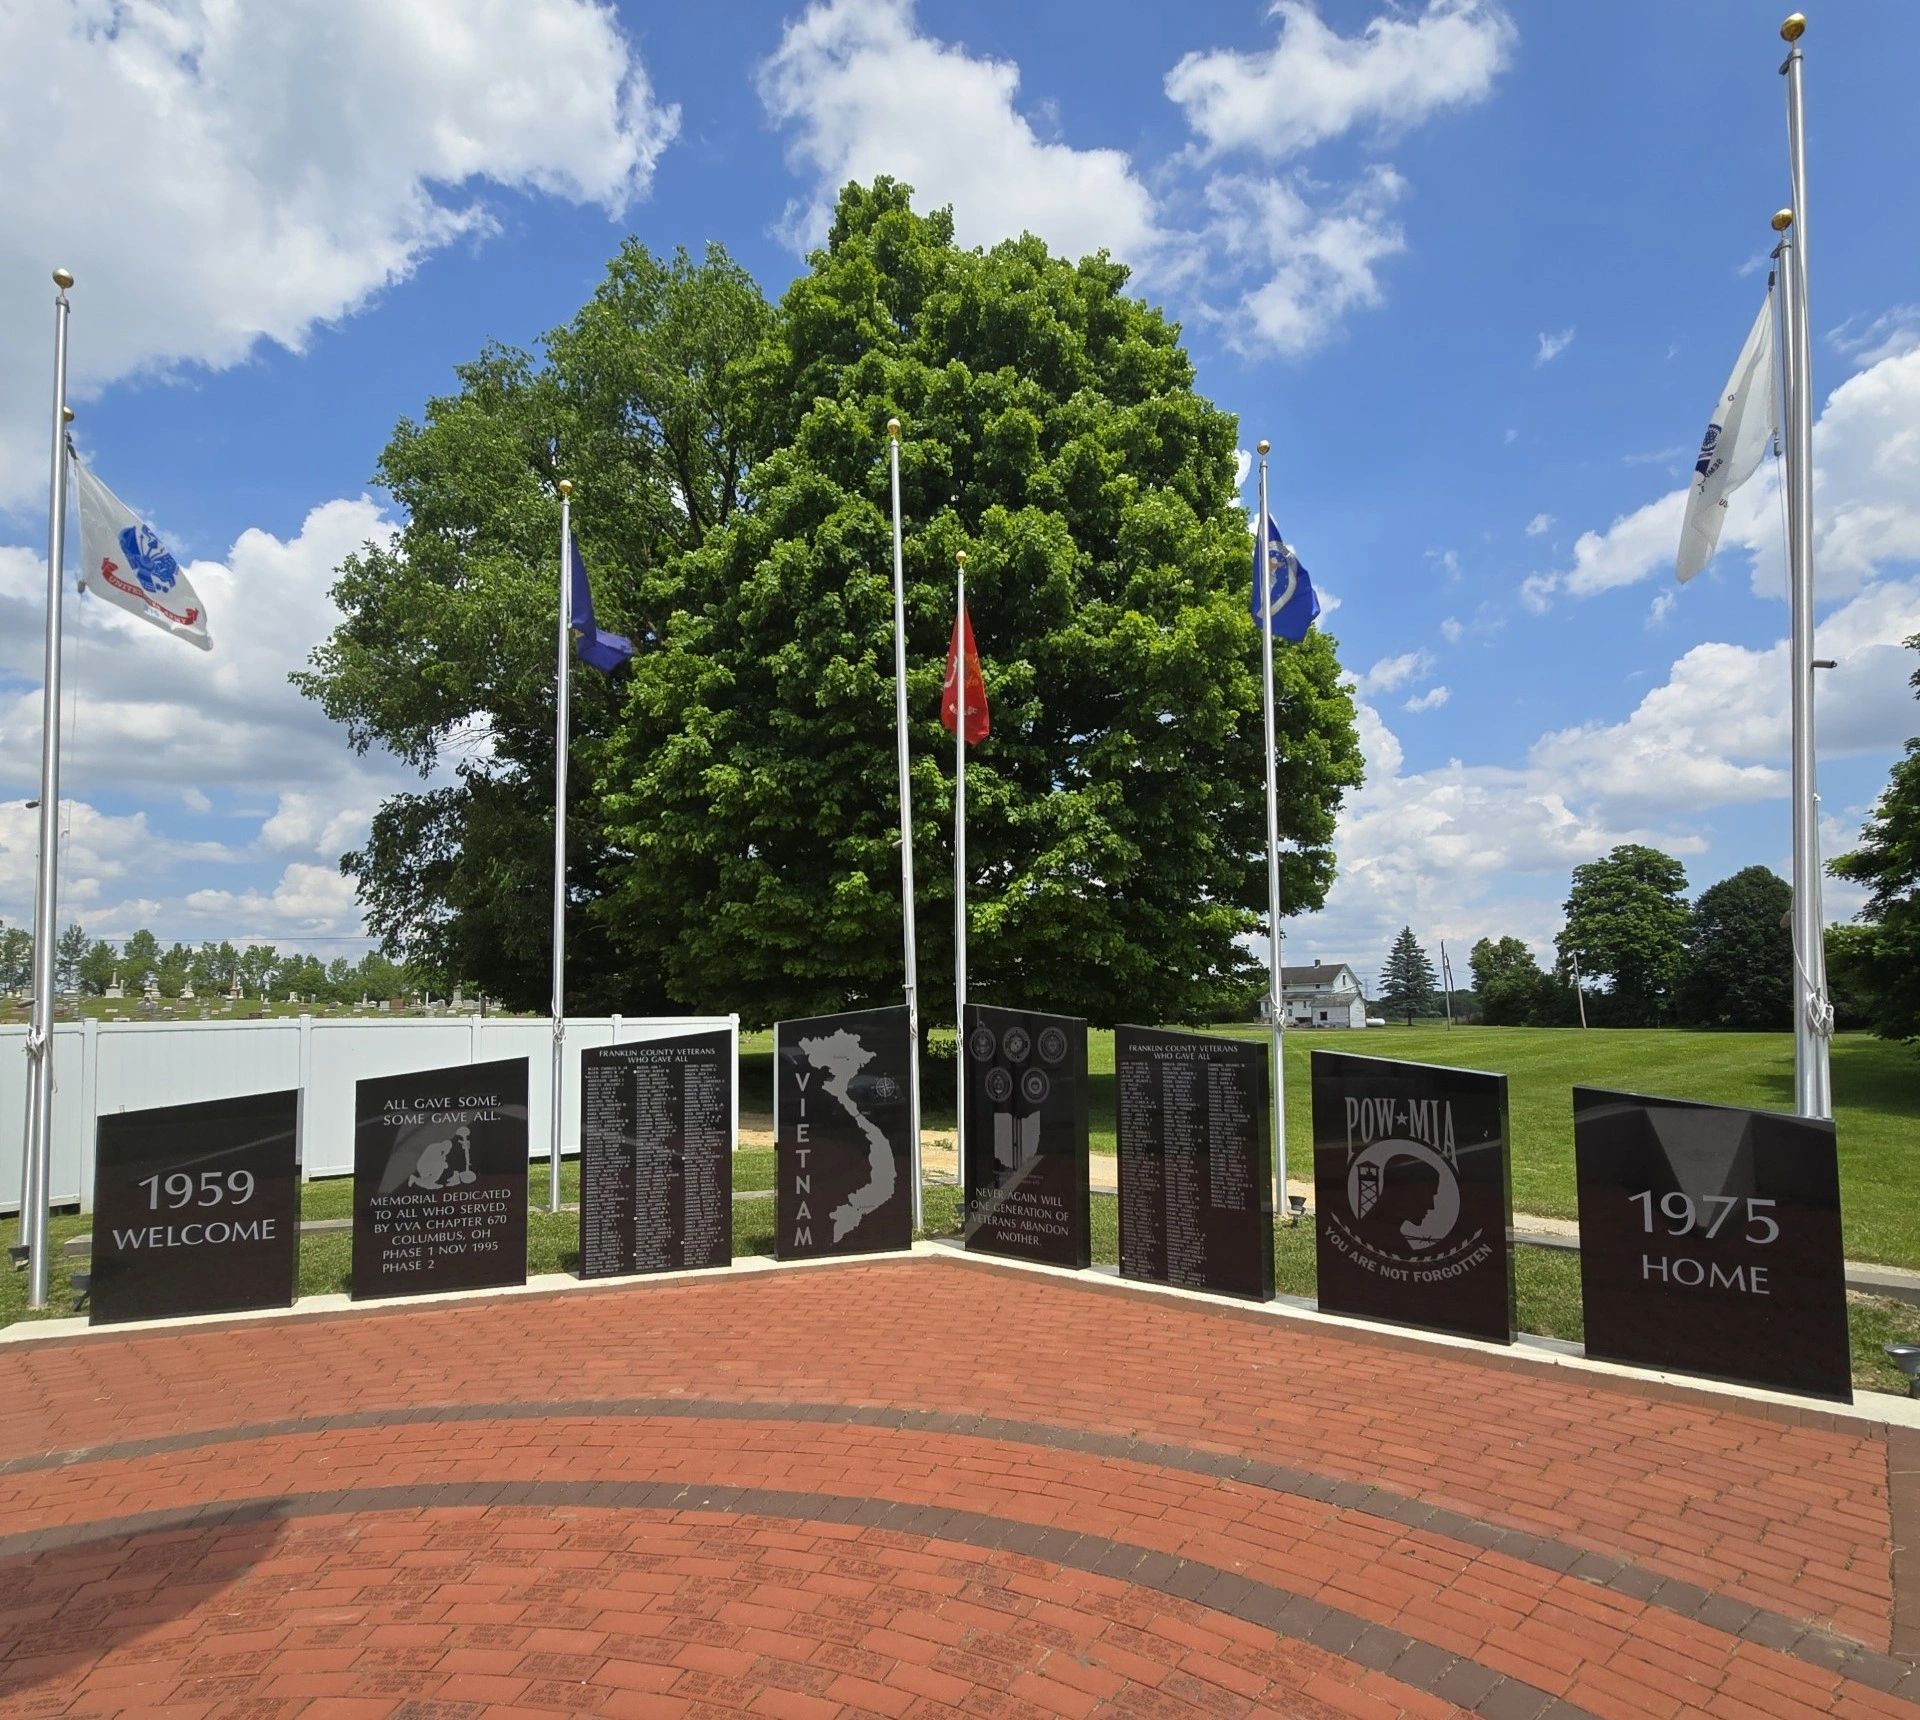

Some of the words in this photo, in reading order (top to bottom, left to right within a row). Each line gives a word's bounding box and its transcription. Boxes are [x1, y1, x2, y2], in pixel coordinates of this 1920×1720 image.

[599, 1049, 638, 1057] FRANKLIN
[640, 1048, 675, 1056] COUNTY
[677, 1047, 716, 1055] VETERANS
[1128, 1044, 1162, 1052] FRANKLIN
[1164, 1044, 1197, 1052] COUNTY
[1153, 1052, 1173, 1060] WHO
[1175, 1052, 1195, 1060] GAVE
[627, 1056, 649, 1064] WHO
[651, 1055, 672, 1063] GAVE
[674, 1055, 688, 1063] ALL
[383, 1099, 409, 1110] ALL
[414, 1097, 451, 1109] GAVE
[458, 1095, 501, 1107] SOME,
[383, 1113, 425, 1126] SOME
[431, 1111, 467, 1124] GAVE
[474, 1111, 501, 1122] ALL.
[1344, 1096, 1397, 1165] POW
[1408, 1098, 1460, 1173] MIA
[794, 1072, 813, 1247] VIETNAM
[138, 1170, 255, 1210] 1959
[370, 1194, 437, 1207] MEMORIAL
[443, 1189, 511, 1203] DEDICATED
[975, 1187, 1004, 1200] NEVER
[1007, 1190, 1037, 1204] AGAIN
[1040, 1194, 1063, 1207] WILL
[375, 1210, 391, 1220] TO
[396, 1208, 418, 1219] ALL
[422, 1205, 455, 1217] WHO
[460, 1202, 508, 1215] SERVED,
[970, 1199, 990, 1211] ONE
[993, 1203, 1052, 1220] GENERATION
[1055, 1211, 1069, 1222] OF
[1628, 1190, 1780, 1244] 1975
[374, 1223, 390, 1234] BY
[395, 1221, 421, 1232] VVA
[426, 1217, 482, 1230] CHAPTER
[487, 1214, 507, 1225] 670
[971, 1212, 1017, 1229] VETERANS
[1020, 1220, 1069, 1236] ABANDON
[112, 1219, 276, 1250] WELCOME
[391, 1231, 466, 1246] COLUMBUS,
[471, 1229, 491, 1239] OH
[383, 1247, 422, 1259] PHASE
[428, 1246, 433, 1256] 1
[439, 1244, 467, 1255] NOV
[472, 1241, 499, 1252] 1995
[1324, 1225, 1349, 1253] YOU
[1349, 1251, 1378, 1273] ARE
[1380, 1266, 1409, 1282] NOT
[1414, 1243, 1493, 1283] FORGOTTEN
[382, 1261, 422, 1273] PHASE
[428, 1260, 435, 1269] 2
[1642, 1254, 1771, 1295] HOME
